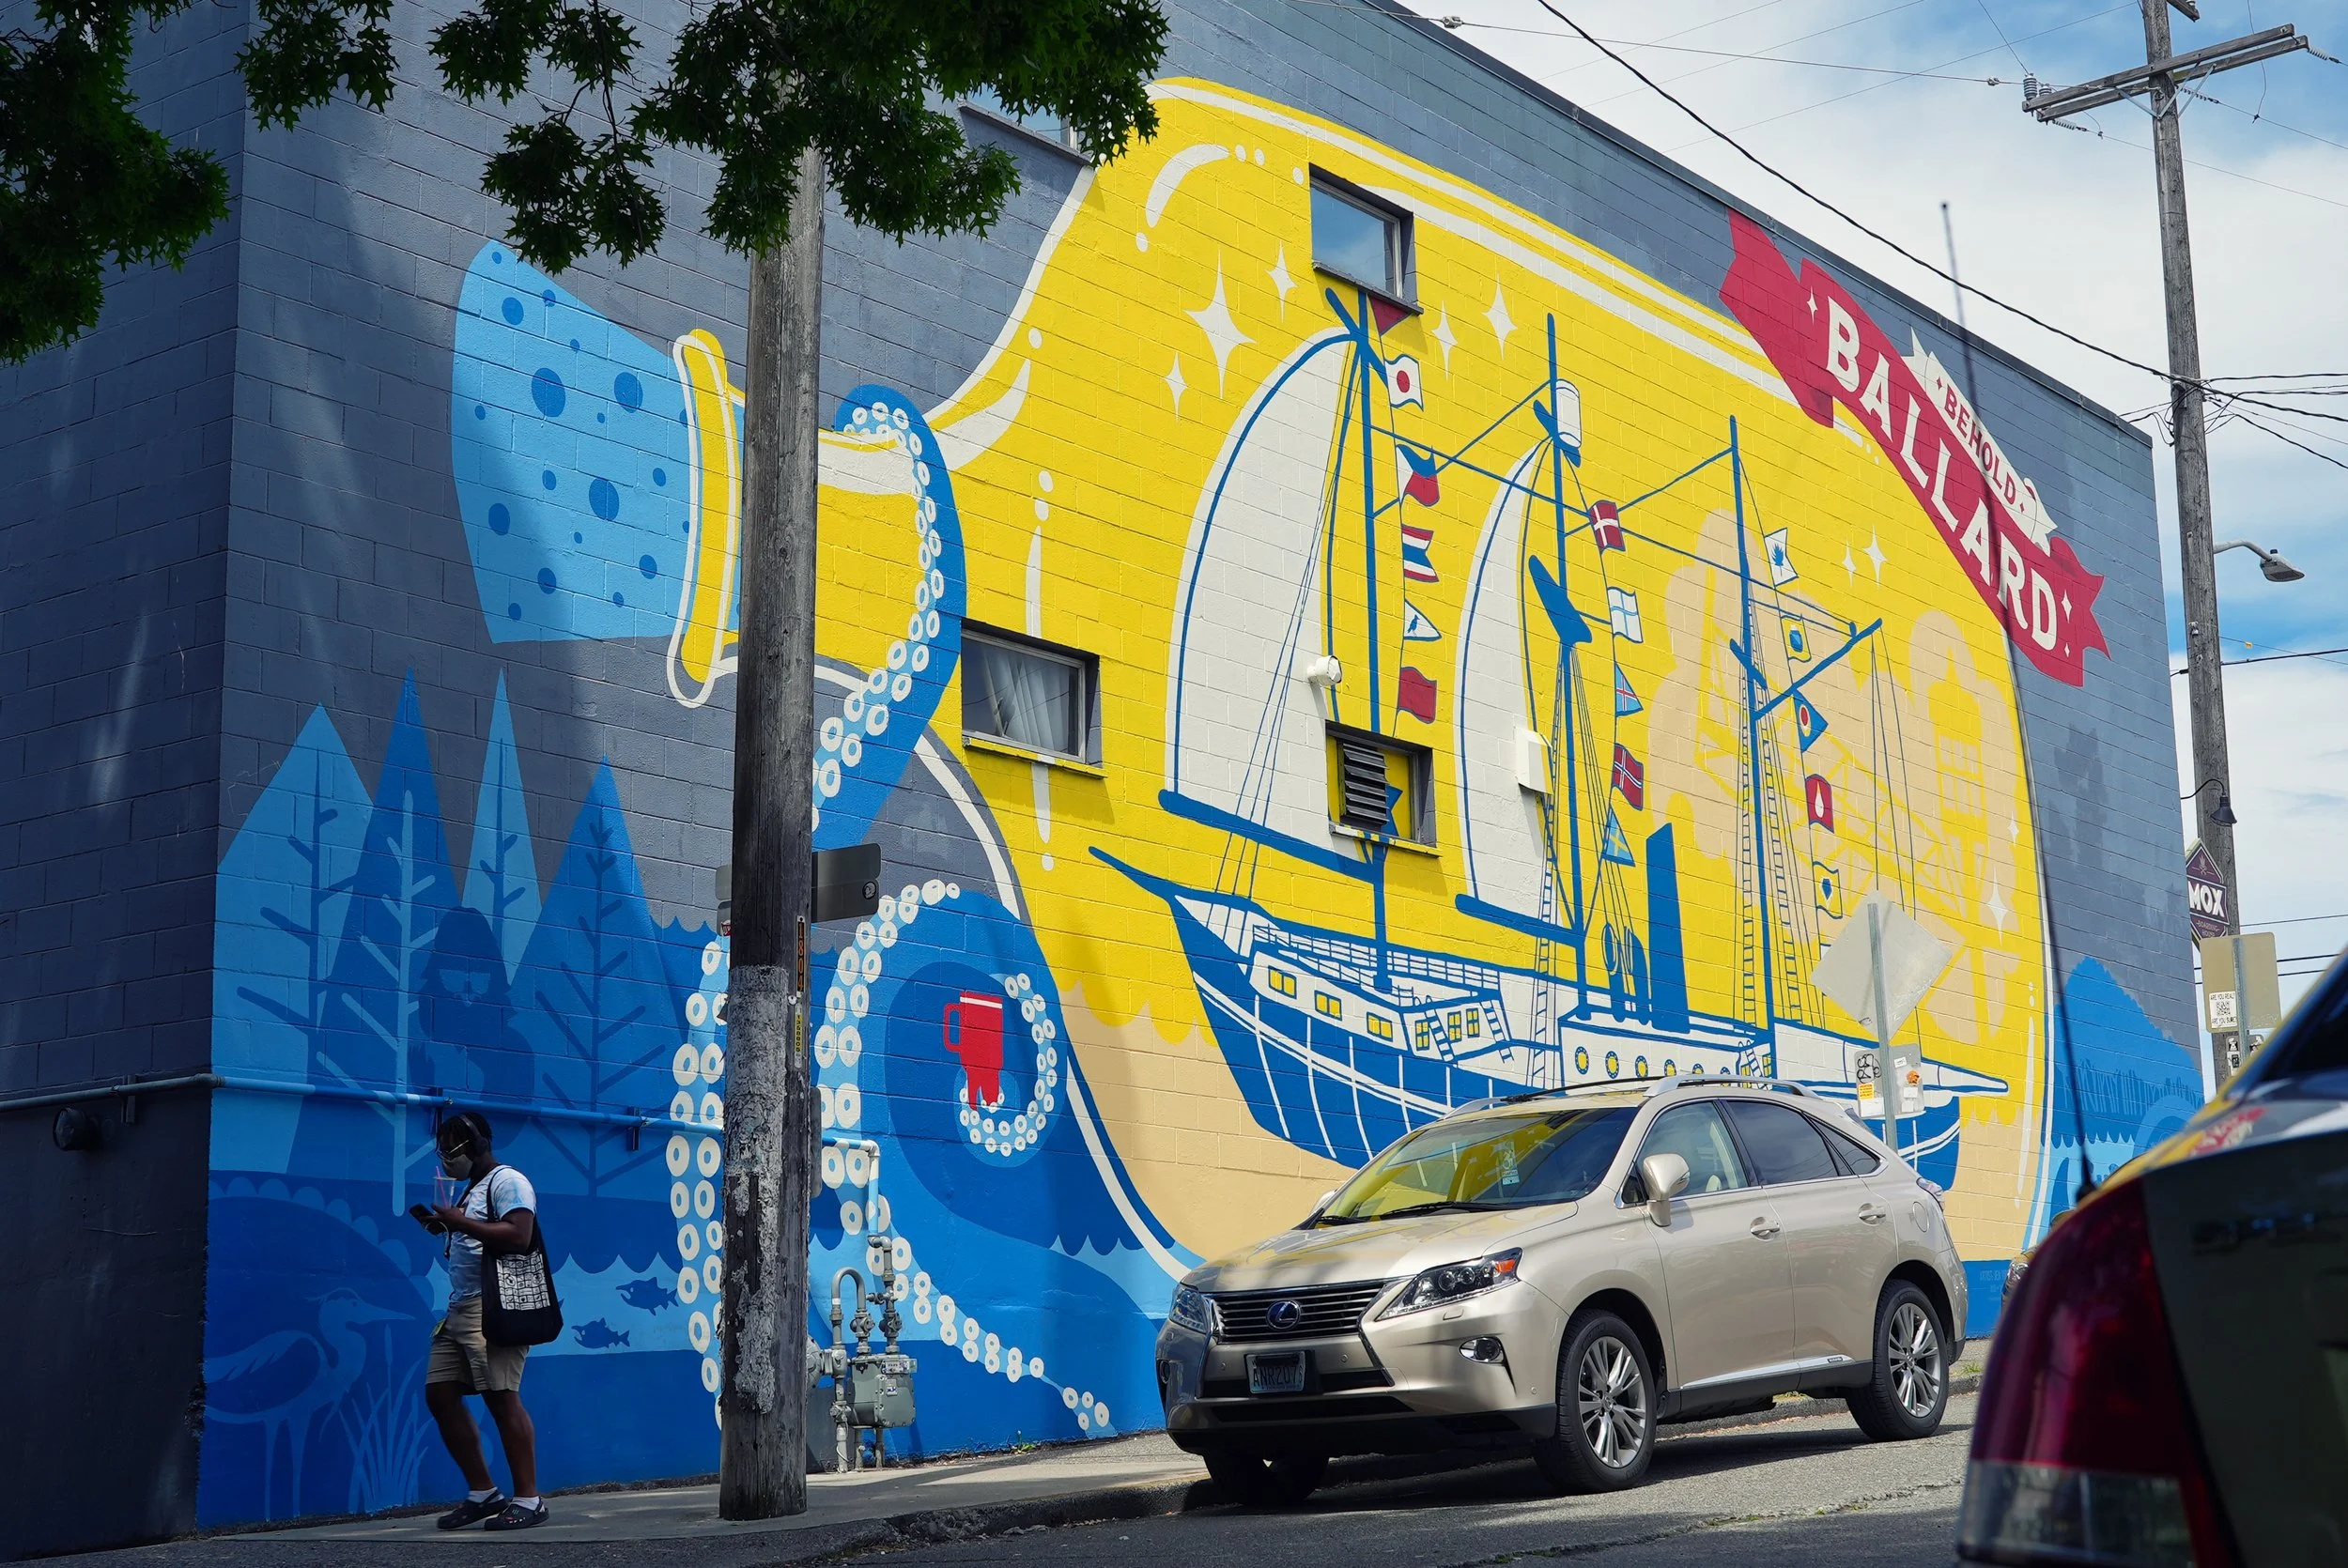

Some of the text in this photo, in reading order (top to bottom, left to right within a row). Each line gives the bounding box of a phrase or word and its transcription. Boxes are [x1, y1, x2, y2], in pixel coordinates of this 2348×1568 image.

[1826, 295, 2058, 651] BALLARD
[1944, 383, 2016, 505] BEHOLD
[2188, 881, 2225, 917] MOX
